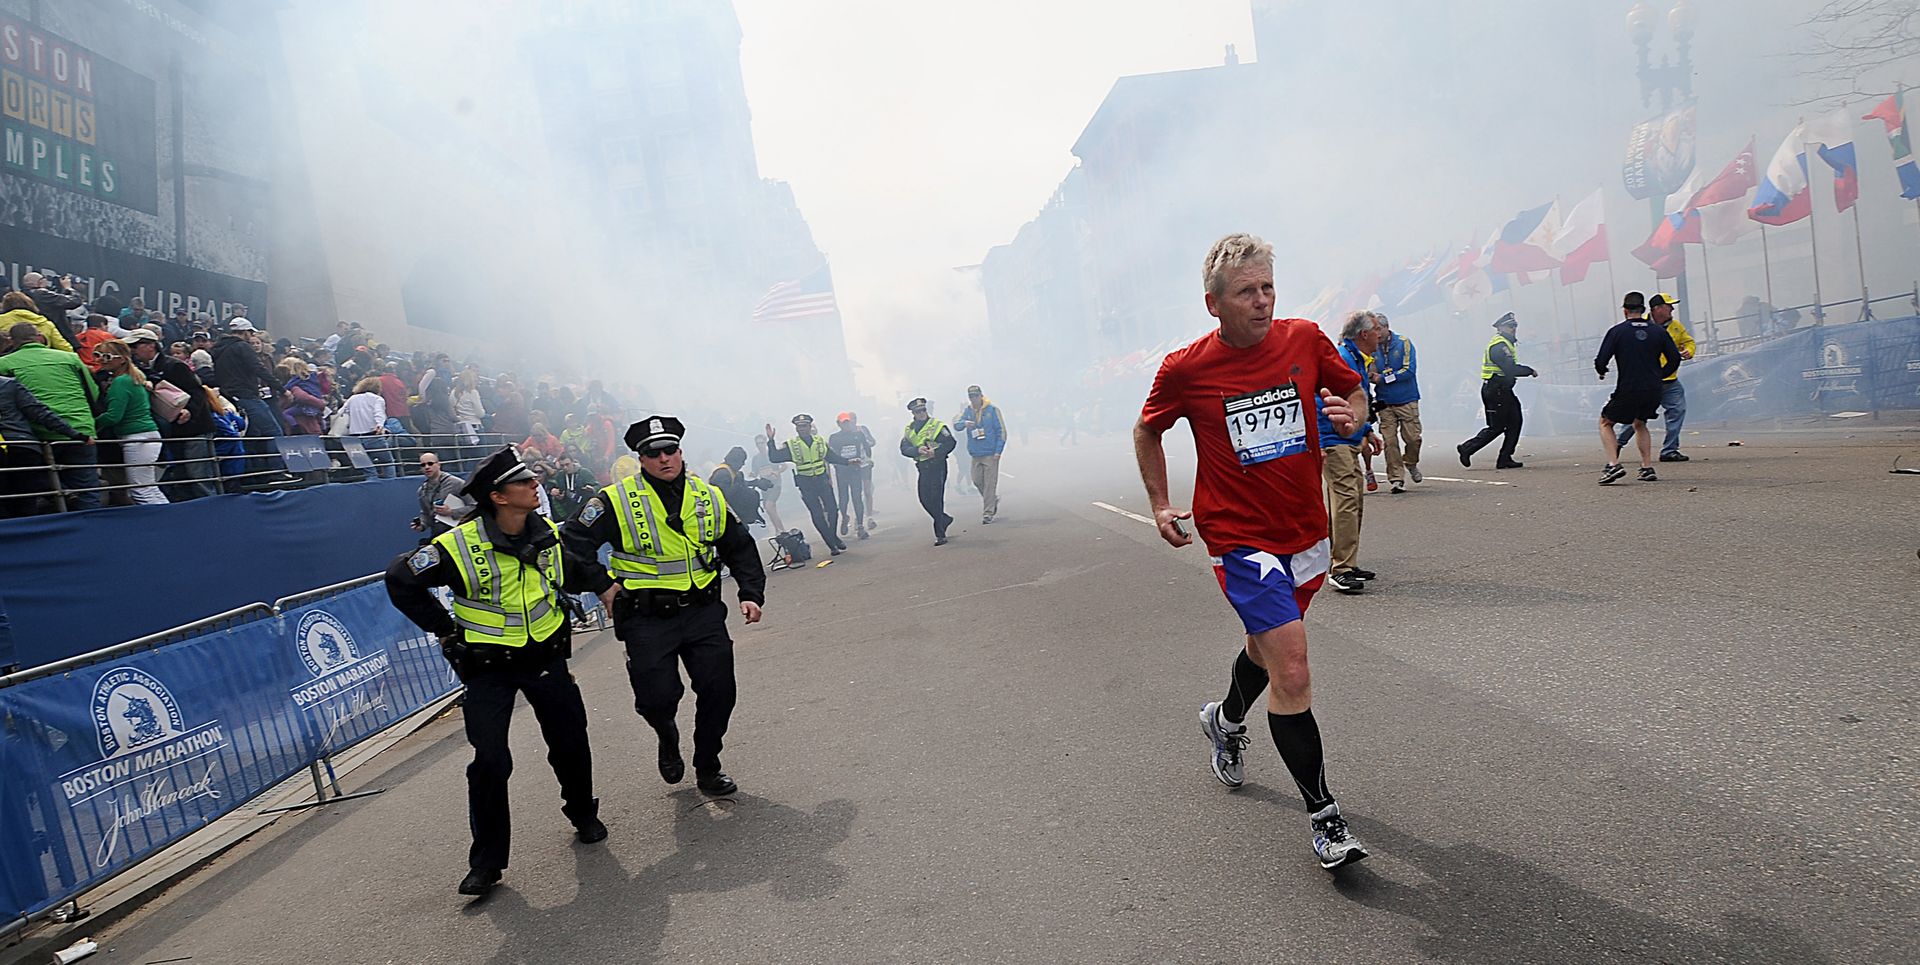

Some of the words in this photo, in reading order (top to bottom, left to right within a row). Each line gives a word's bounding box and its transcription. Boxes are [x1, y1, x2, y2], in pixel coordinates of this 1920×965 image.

[5, 24, 92, 92] STON
[6, 76, 93, 142] ORTS
[6, 128, 115, 193] MPLES
[1635, 122, 1649, 188] MARATHON
[1231, 402, 1300, 435] 19797
[1253, 388, 1297, 406] adidas
[1237, 438, 1243, 446] 2
[629, 491, 653, 550] BOSTON
[97, 672, 131, 704] ATHLETIC
[133, 672, 181, 727] ASSOCIATION
[291, 677, 338, 706] BOSTON
[336, 653, 389, 687] MARATHON
[95, 705, 116, 751] BOSTON
[61, 758, 130, 800] BOSTON
[135, 726, 222, 772] MARATHON
